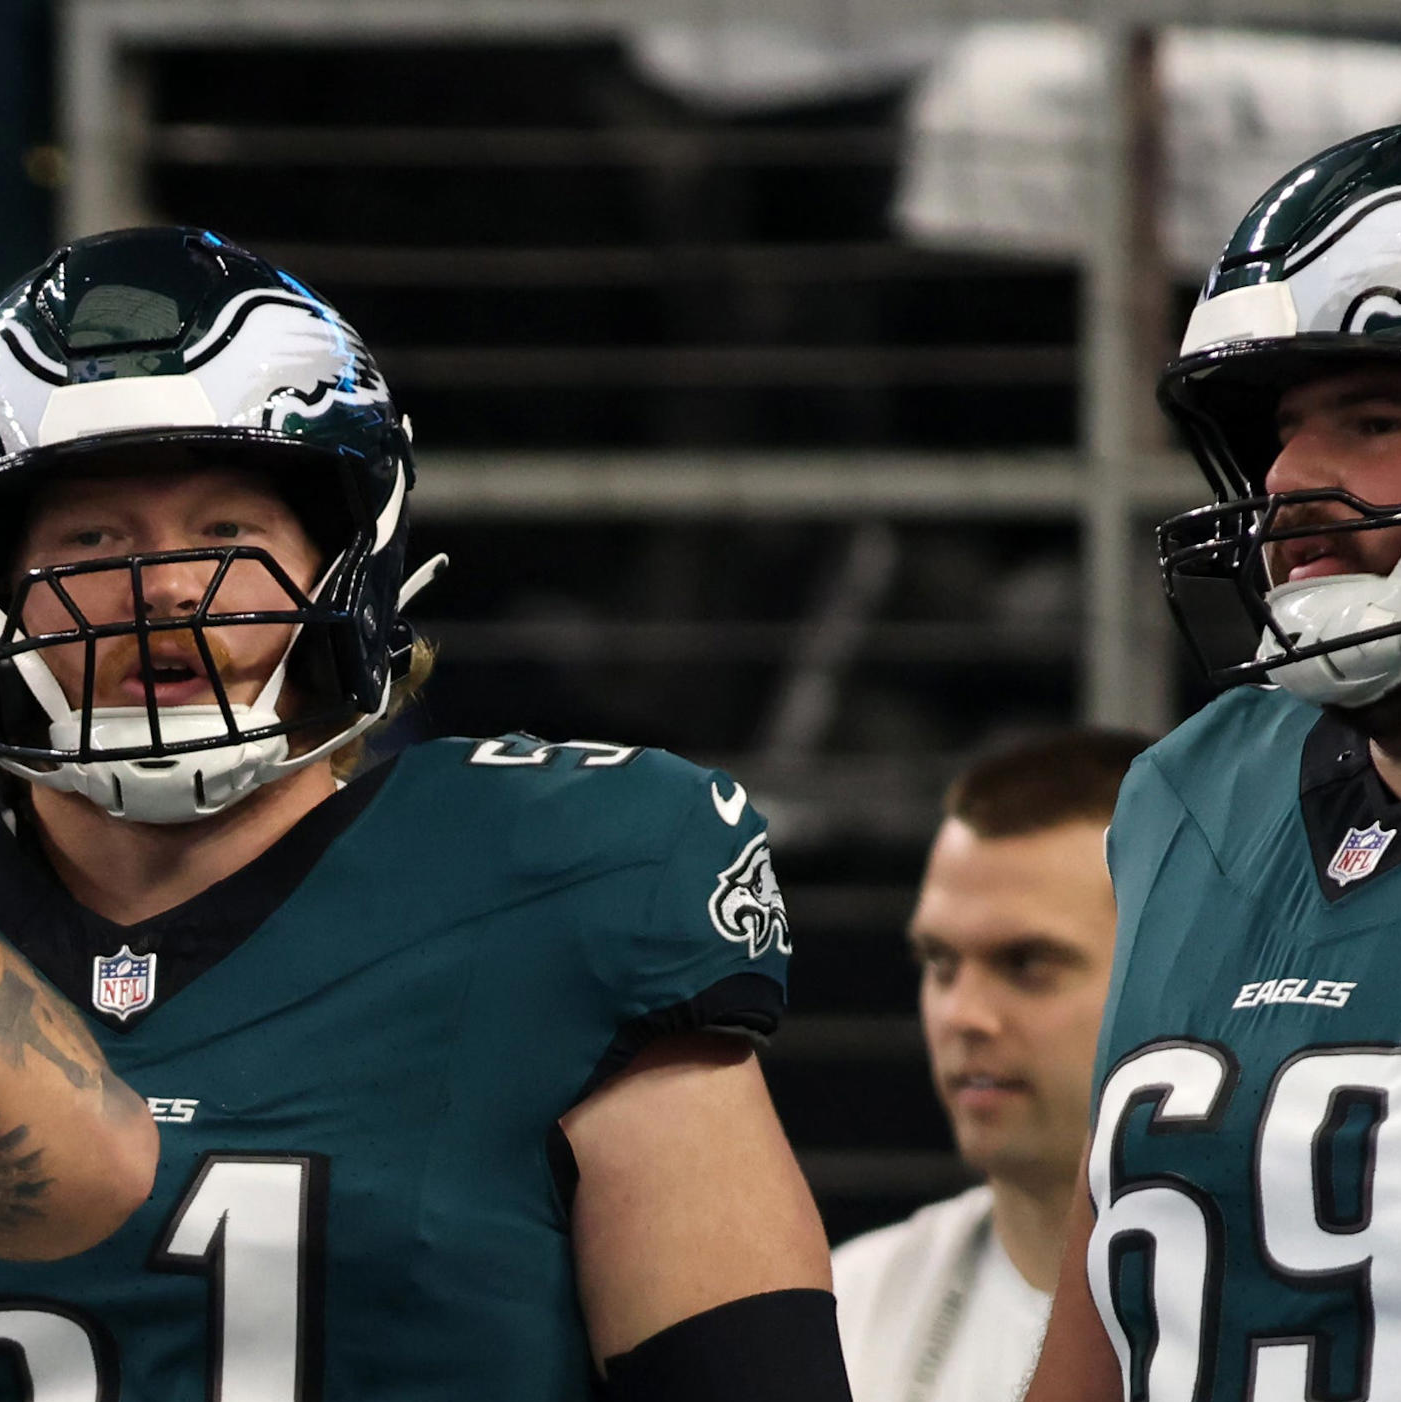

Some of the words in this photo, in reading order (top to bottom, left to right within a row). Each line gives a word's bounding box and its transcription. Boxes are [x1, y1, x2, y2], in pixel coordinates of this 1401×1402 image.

[1336, 849, 1375, 873] NFL
[102, 978, 145, 1006] NFL
[1231, 978, 1358, 1010] EAGLES
